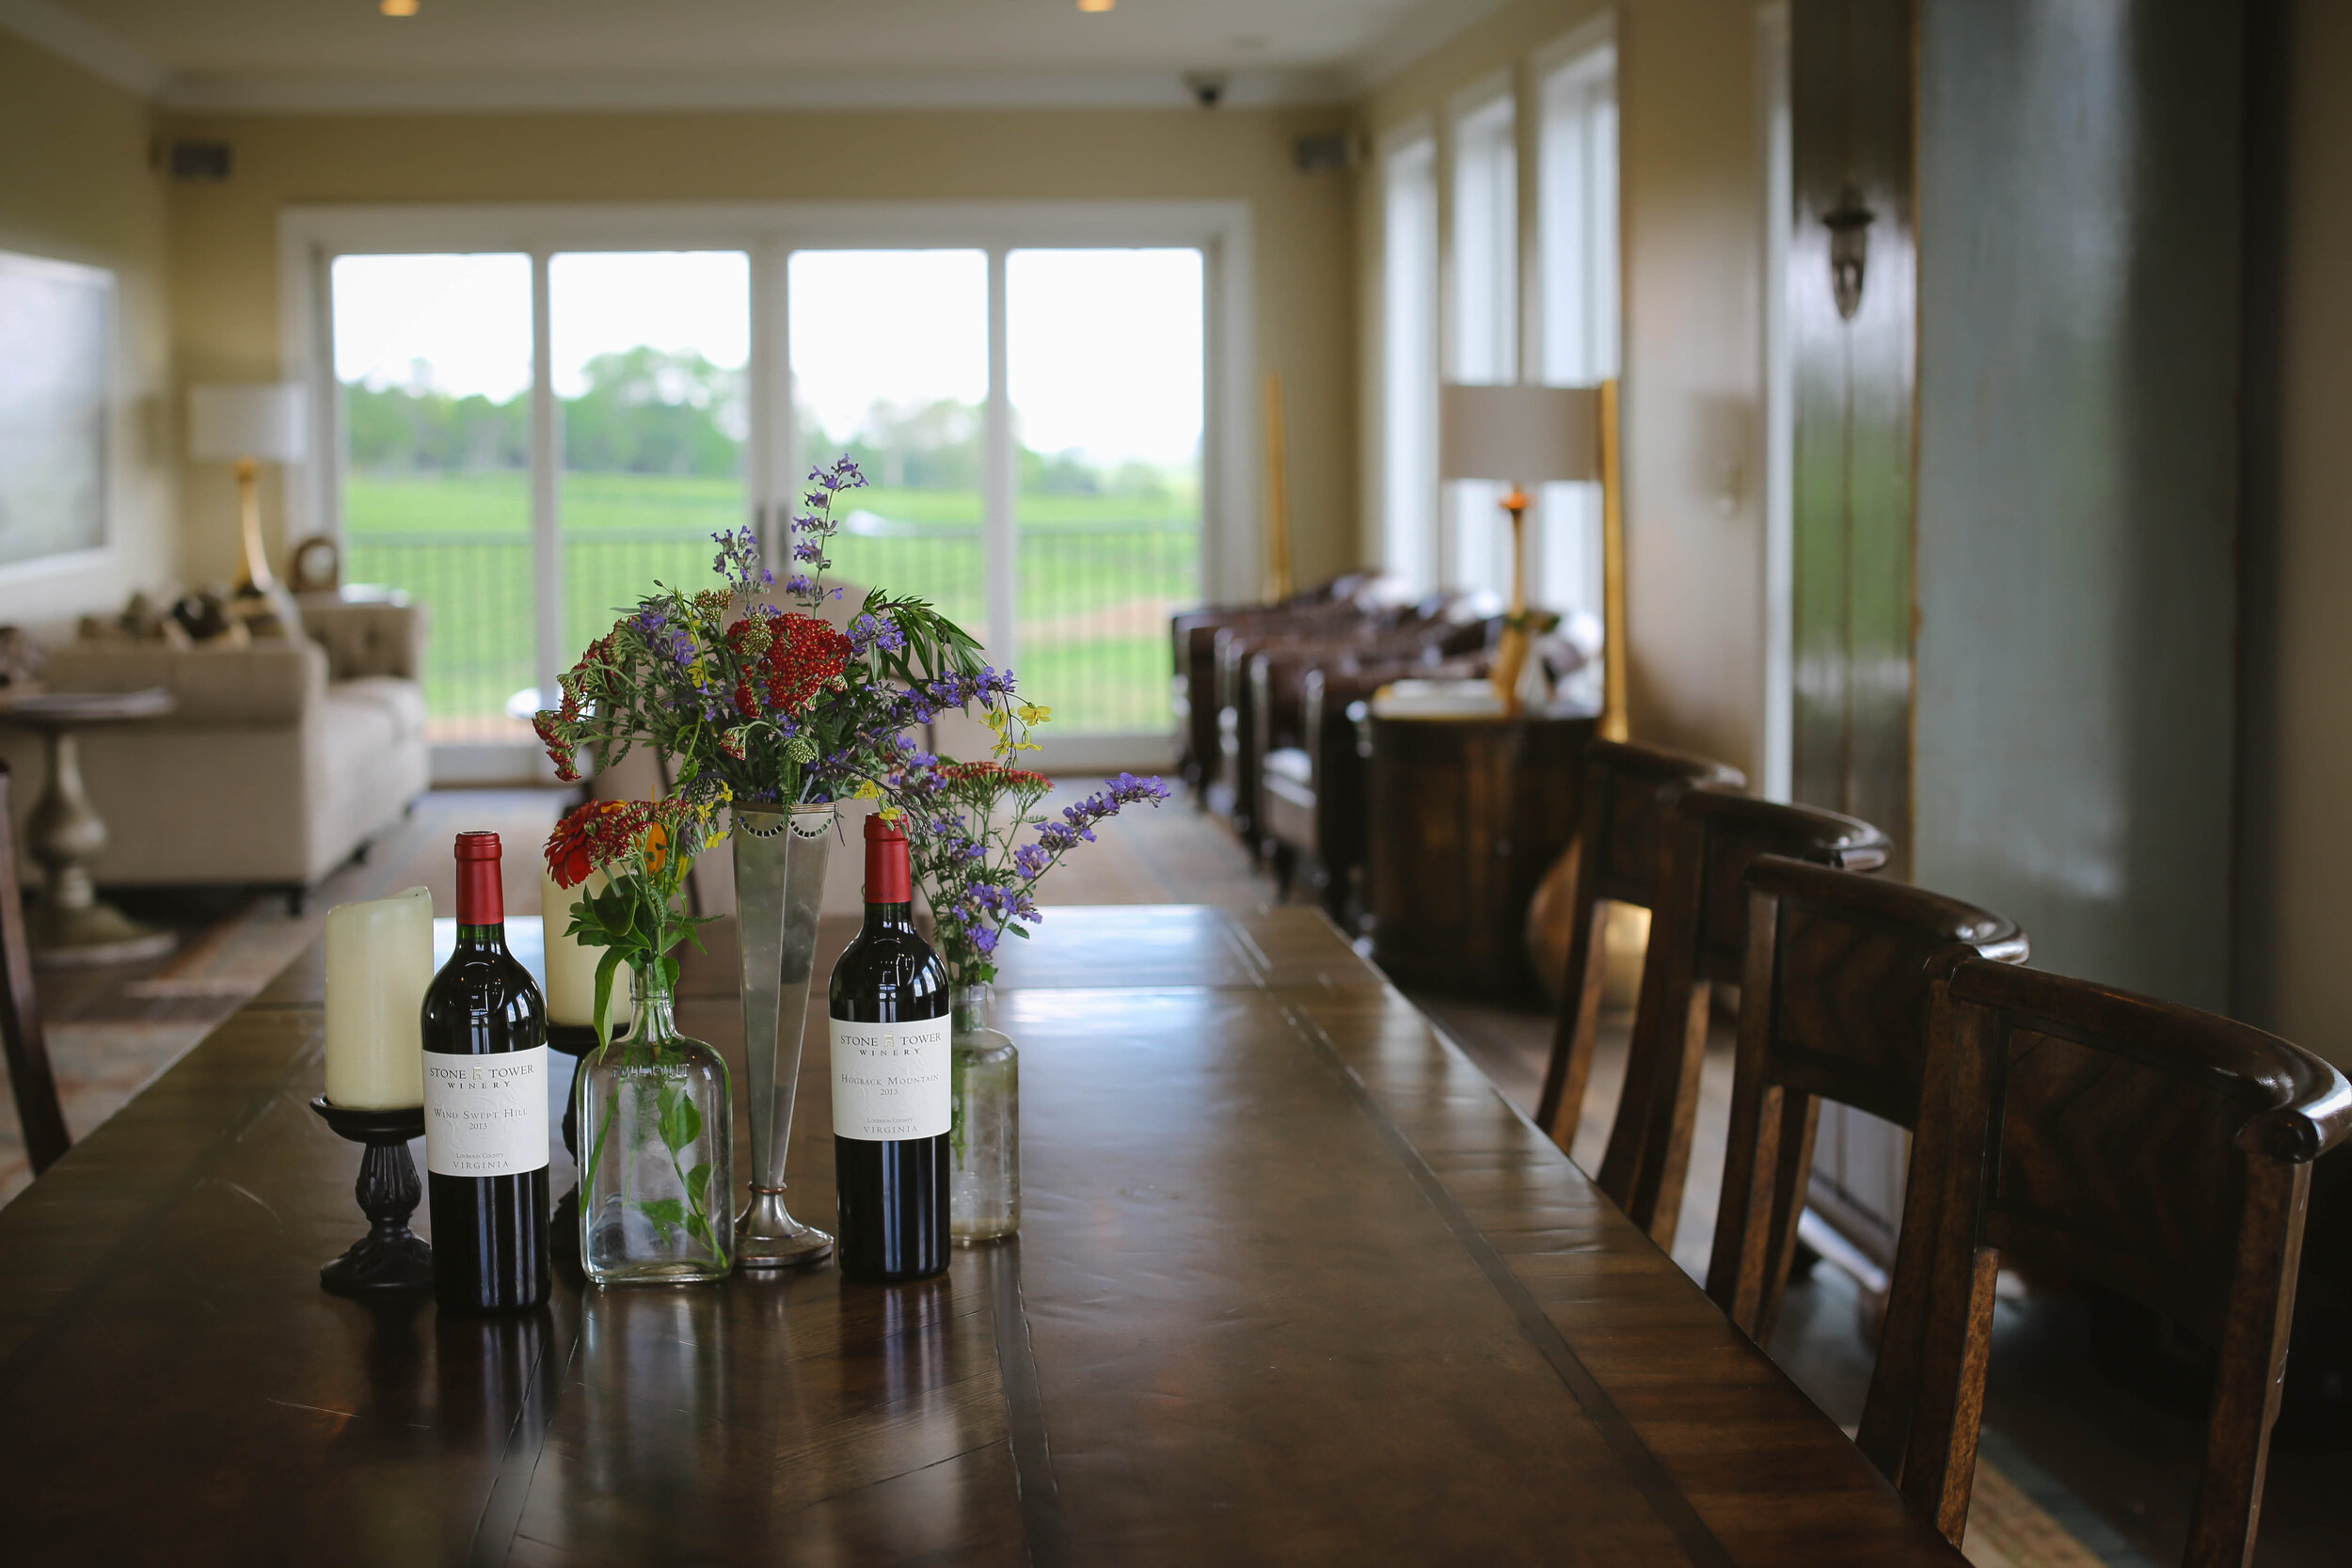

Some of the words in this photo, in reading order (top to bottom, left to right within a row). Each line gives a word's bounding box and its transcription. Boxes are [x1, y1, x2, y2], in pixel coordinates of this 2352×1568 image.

[840, 1035, 879, 1047] STONE
[900, 1032, 942, 1046] TOWER
[860, 1048, 920, 1056] WINERY
[429, 1067, 467, 1080] STONE
[488, 1064, 534, 1079] TOWER
[447, 1081, 511, 1089] WINERY
[469, 1122, 488, 1131] 2013
[864, 1125, 918, 1133] VIRGINIA
[453, 1160, 510, 1169] VIRGINIA
